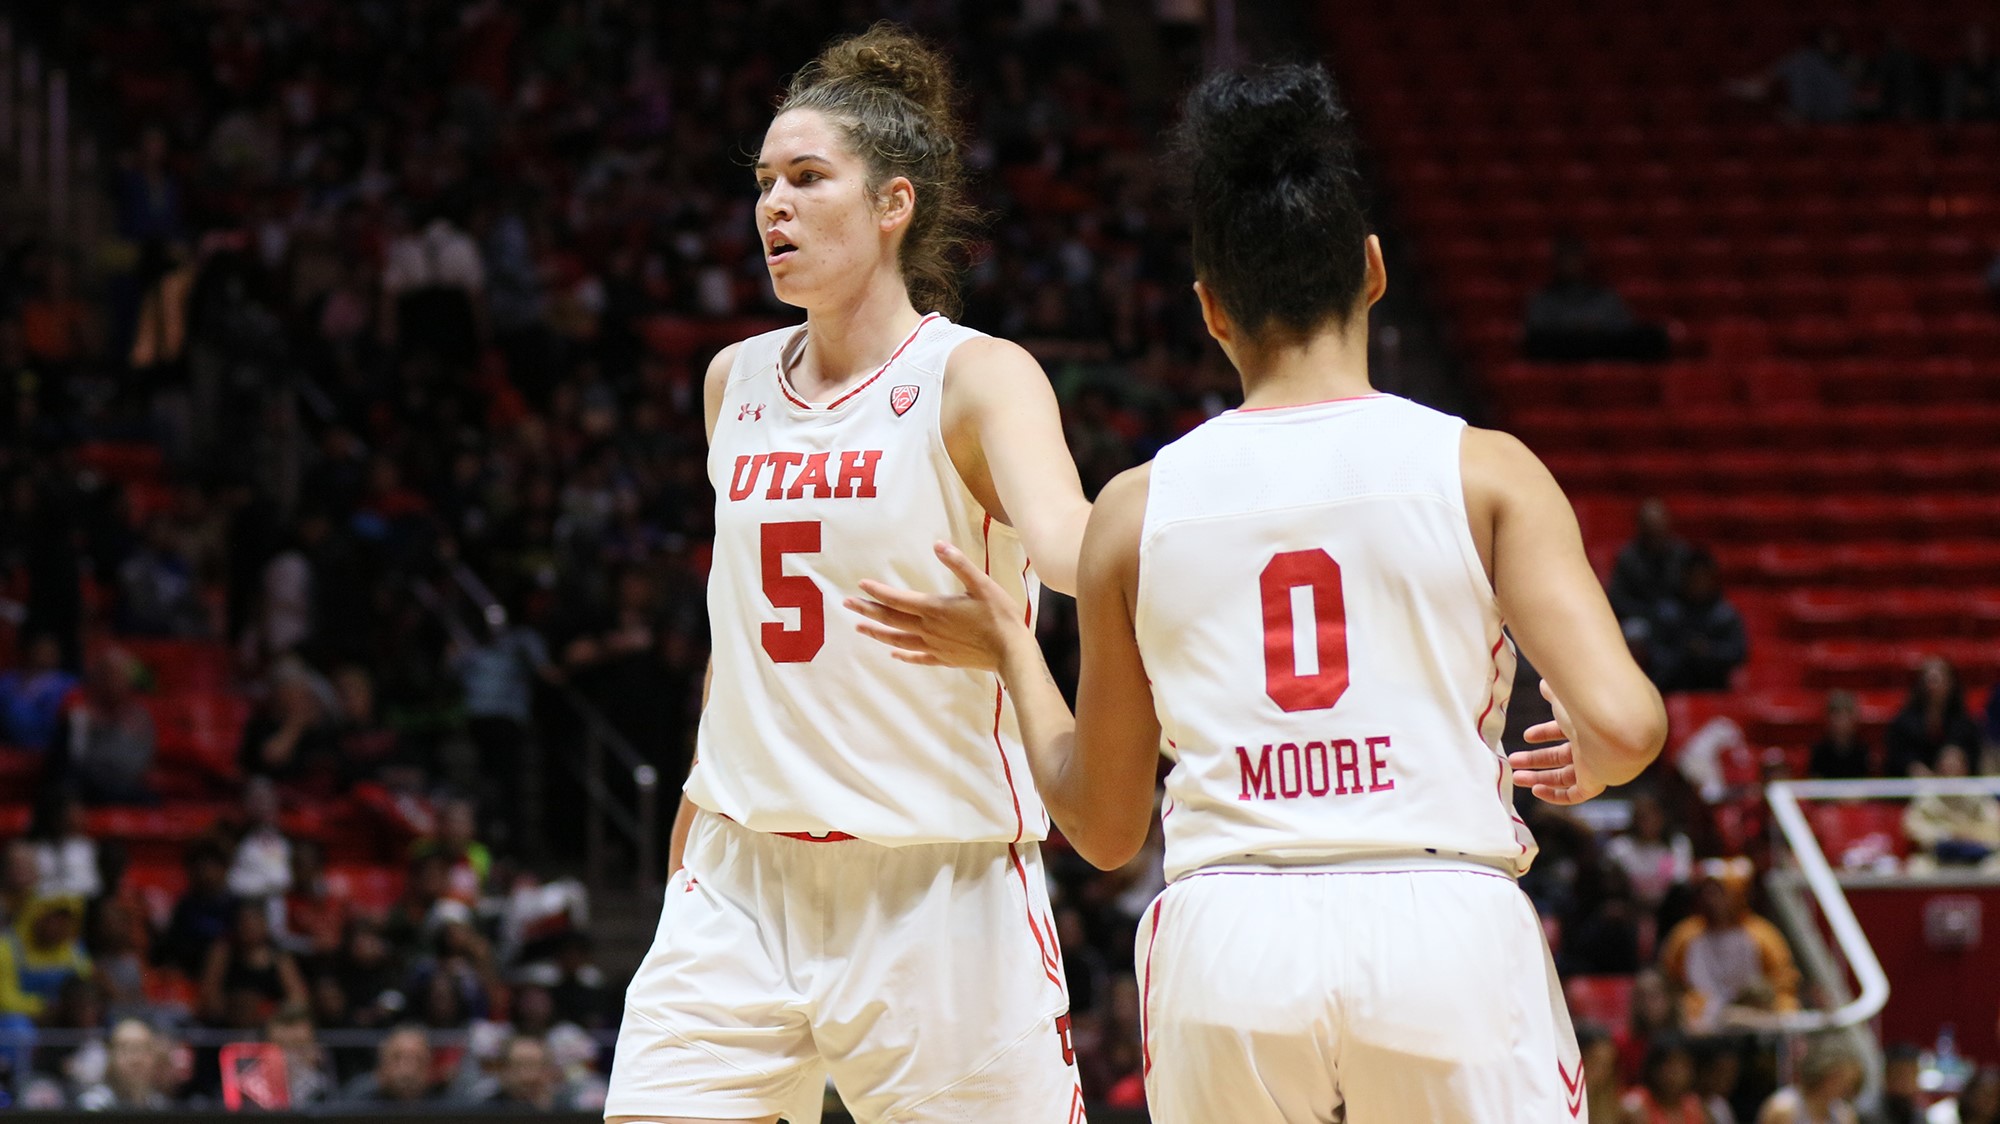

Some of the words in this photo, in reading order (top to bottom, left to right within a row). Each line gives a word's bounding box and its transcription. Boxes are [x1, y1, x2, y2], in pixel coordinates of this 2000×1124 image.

[896, 397, 910, 409] 12
[729, 450, 883, 502] UTAH
[760, 520, 825, 663] 5
[1259, 548, 1350, 713] 0
[1235, 736, 1395, 800] MOORE
